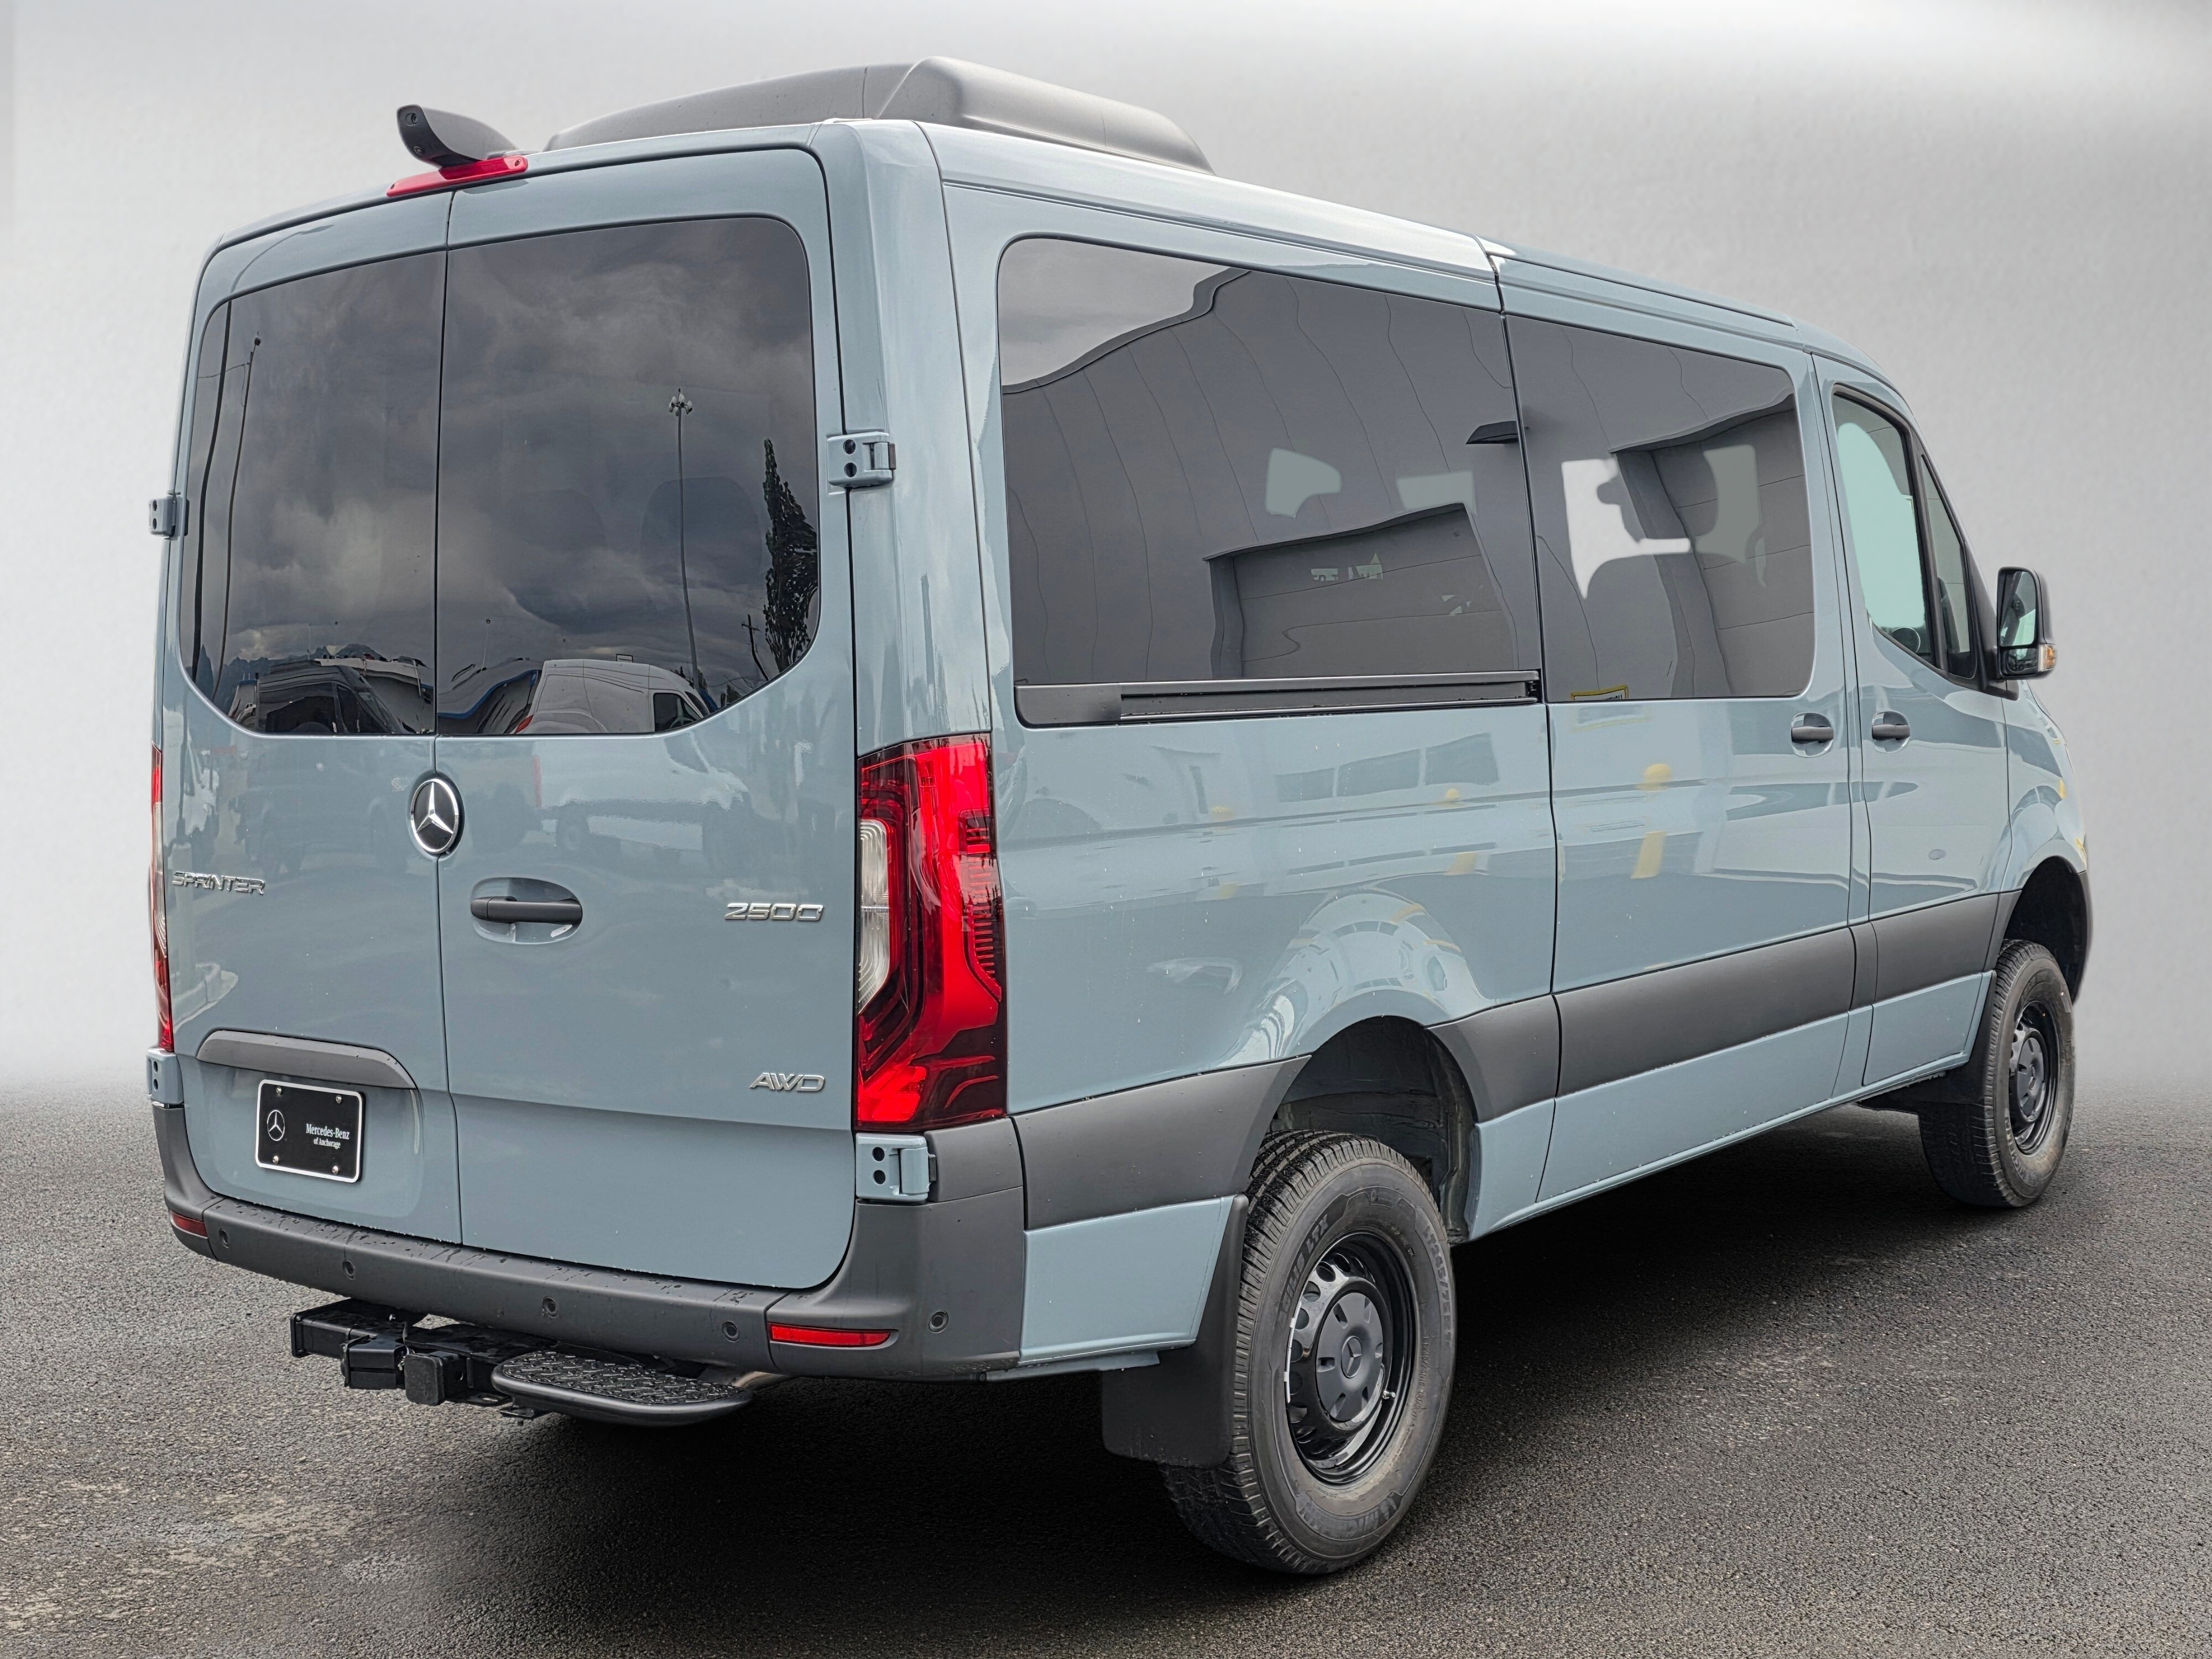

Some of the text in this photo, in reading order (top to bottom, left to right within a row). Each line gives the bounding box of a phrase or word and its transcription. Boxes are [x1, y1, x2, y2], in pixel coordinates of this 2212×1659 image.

[172, 871, 265, 895] SPRINTER
[724, 902, 823, 921] 2500
[749, 1072, 825, 1092] AWD
[306, 1124, 349, 1139] Mercedes-Benz
[319, 1139, 341, 1149] Anchorage
